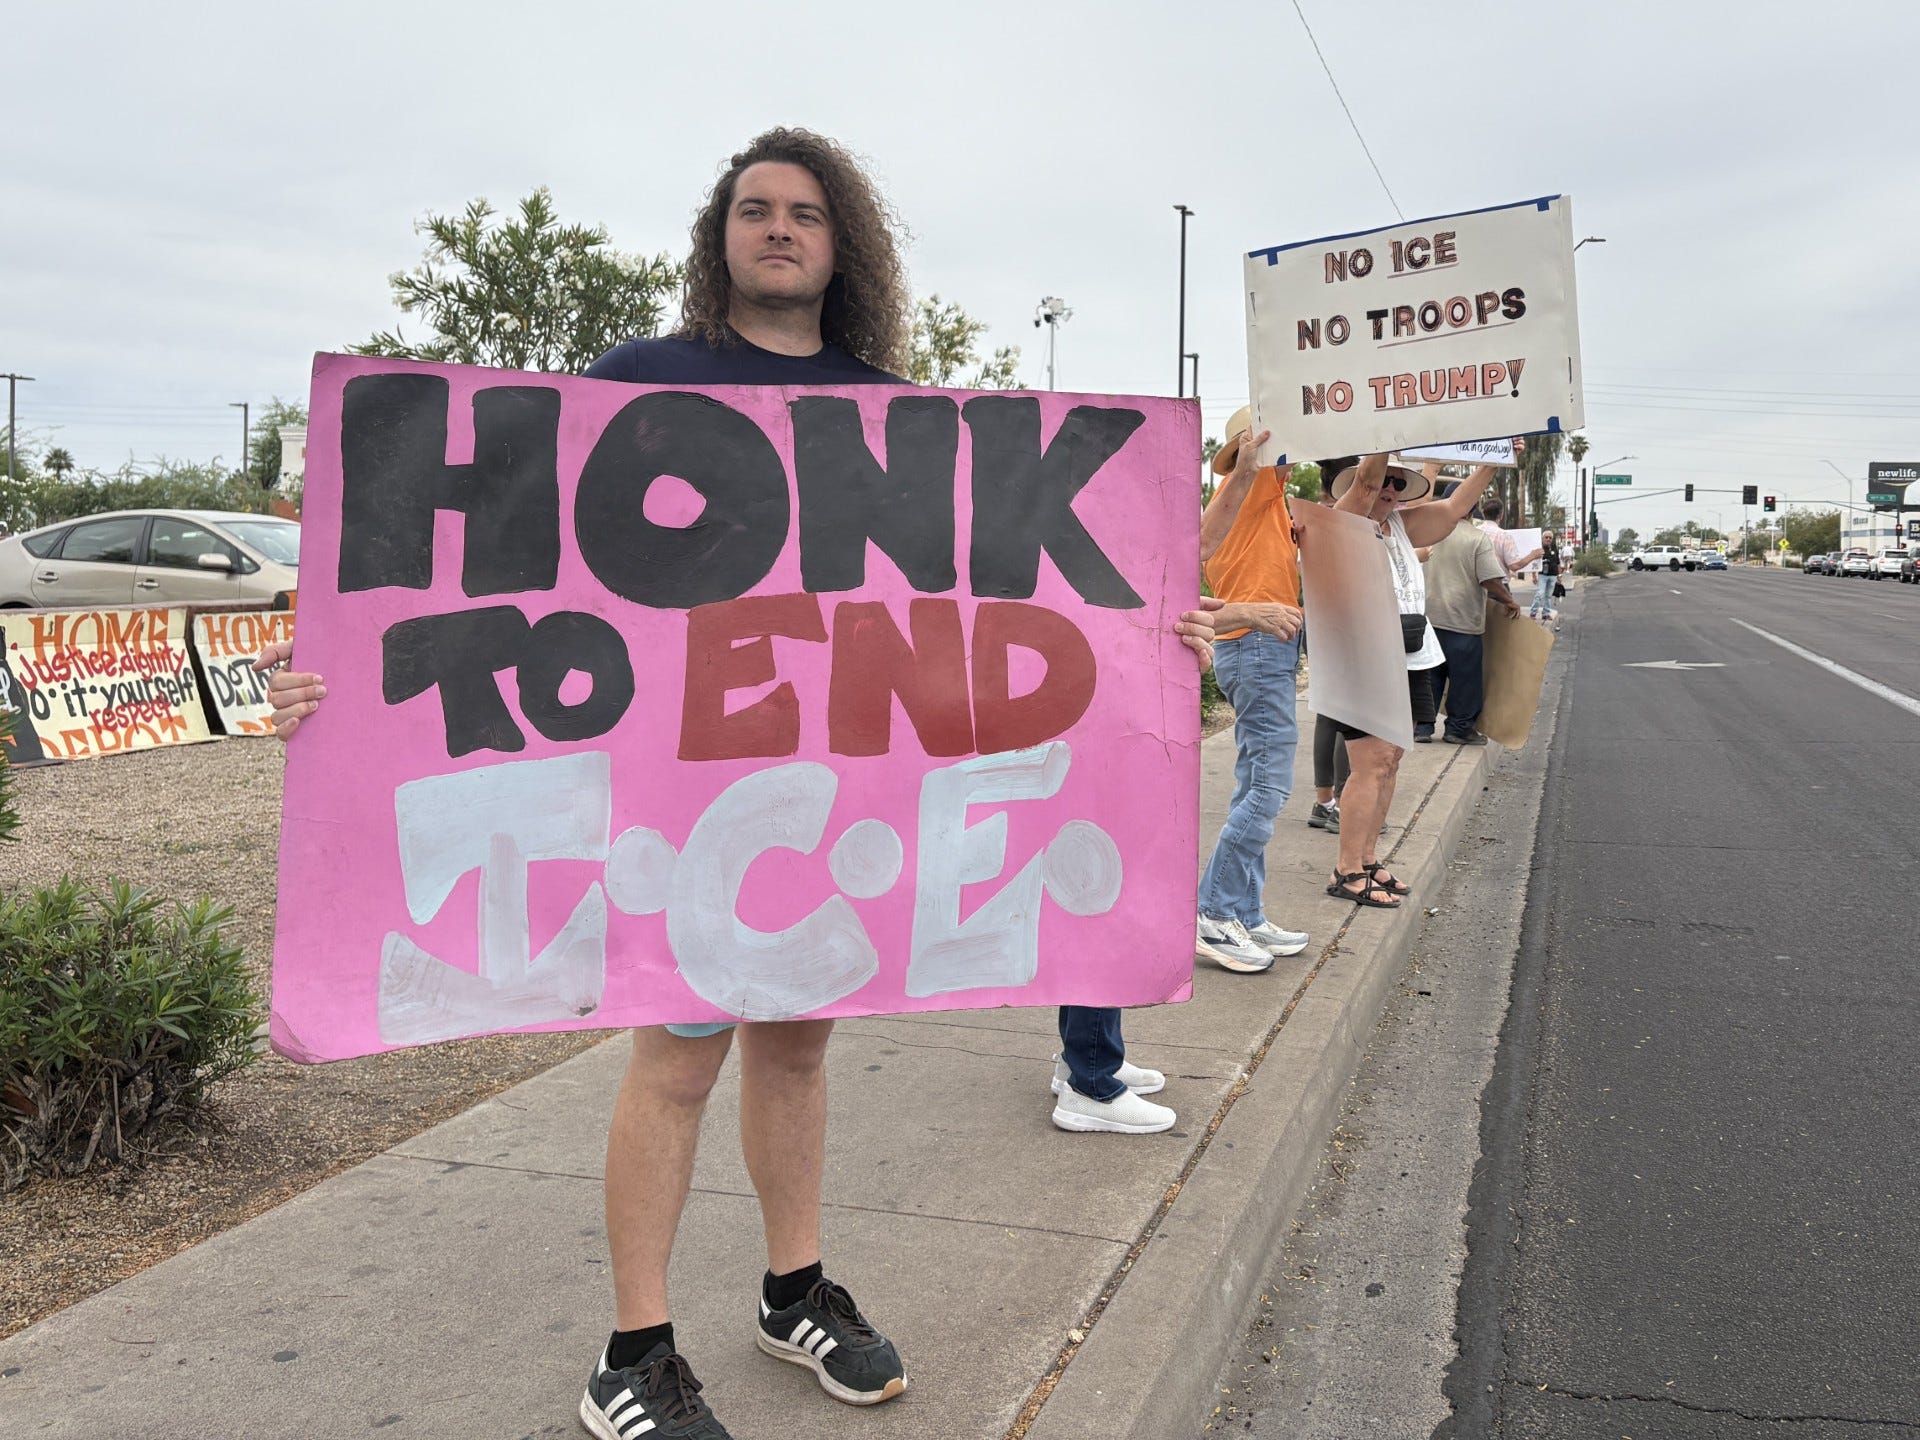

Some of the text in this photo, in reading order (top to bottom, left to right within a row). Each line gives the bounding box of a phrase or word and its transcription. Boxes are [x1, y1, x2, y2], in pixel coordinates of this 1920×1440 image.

[1324, 231, 1457, 283] NO ICE
[1297, 287, 1526, 351] NO TROOPS
[1302, 358, 1526, 415] NO TRUMP!
[338, 373, 1146, 609] HONK
[28, 609, 169, 666] HOME
[382, 592, 1097, 762] TO END
[89, 692, 172, 734] respect
